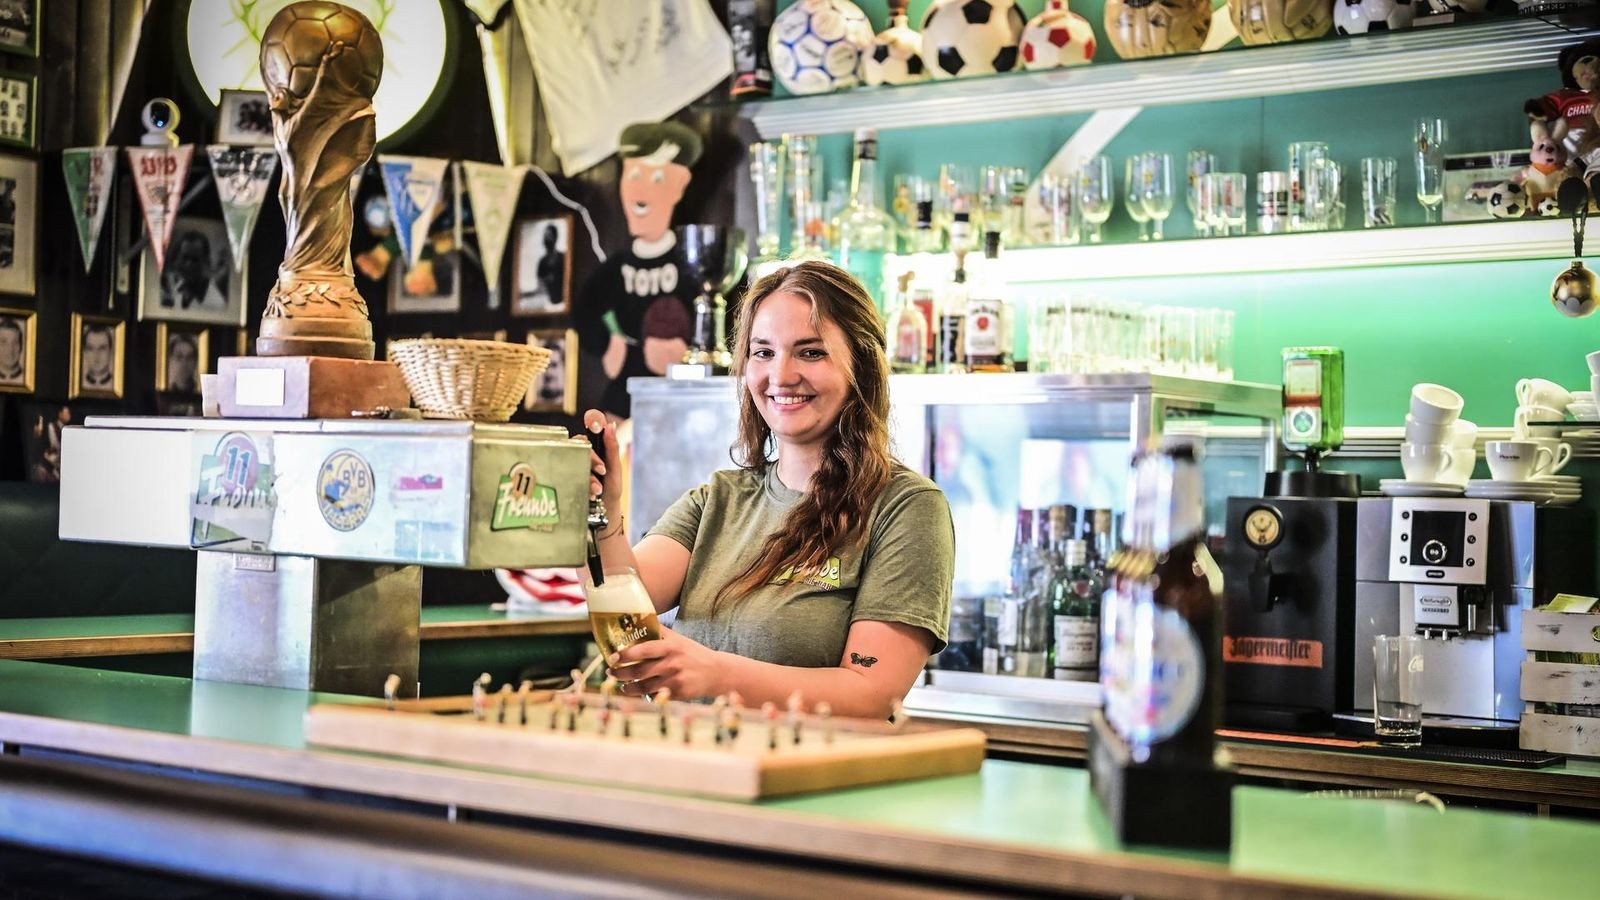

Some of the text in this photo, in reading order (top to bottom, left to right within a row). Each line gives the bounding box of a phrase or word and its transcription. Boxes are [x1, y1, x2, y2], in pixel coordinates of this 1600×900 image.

[621, 262, 679, 297] TOTO
[227, 445, 251, 487] 11
[516, 472, 531, 496] 11
[497, 483, 558, 524] Freunde
